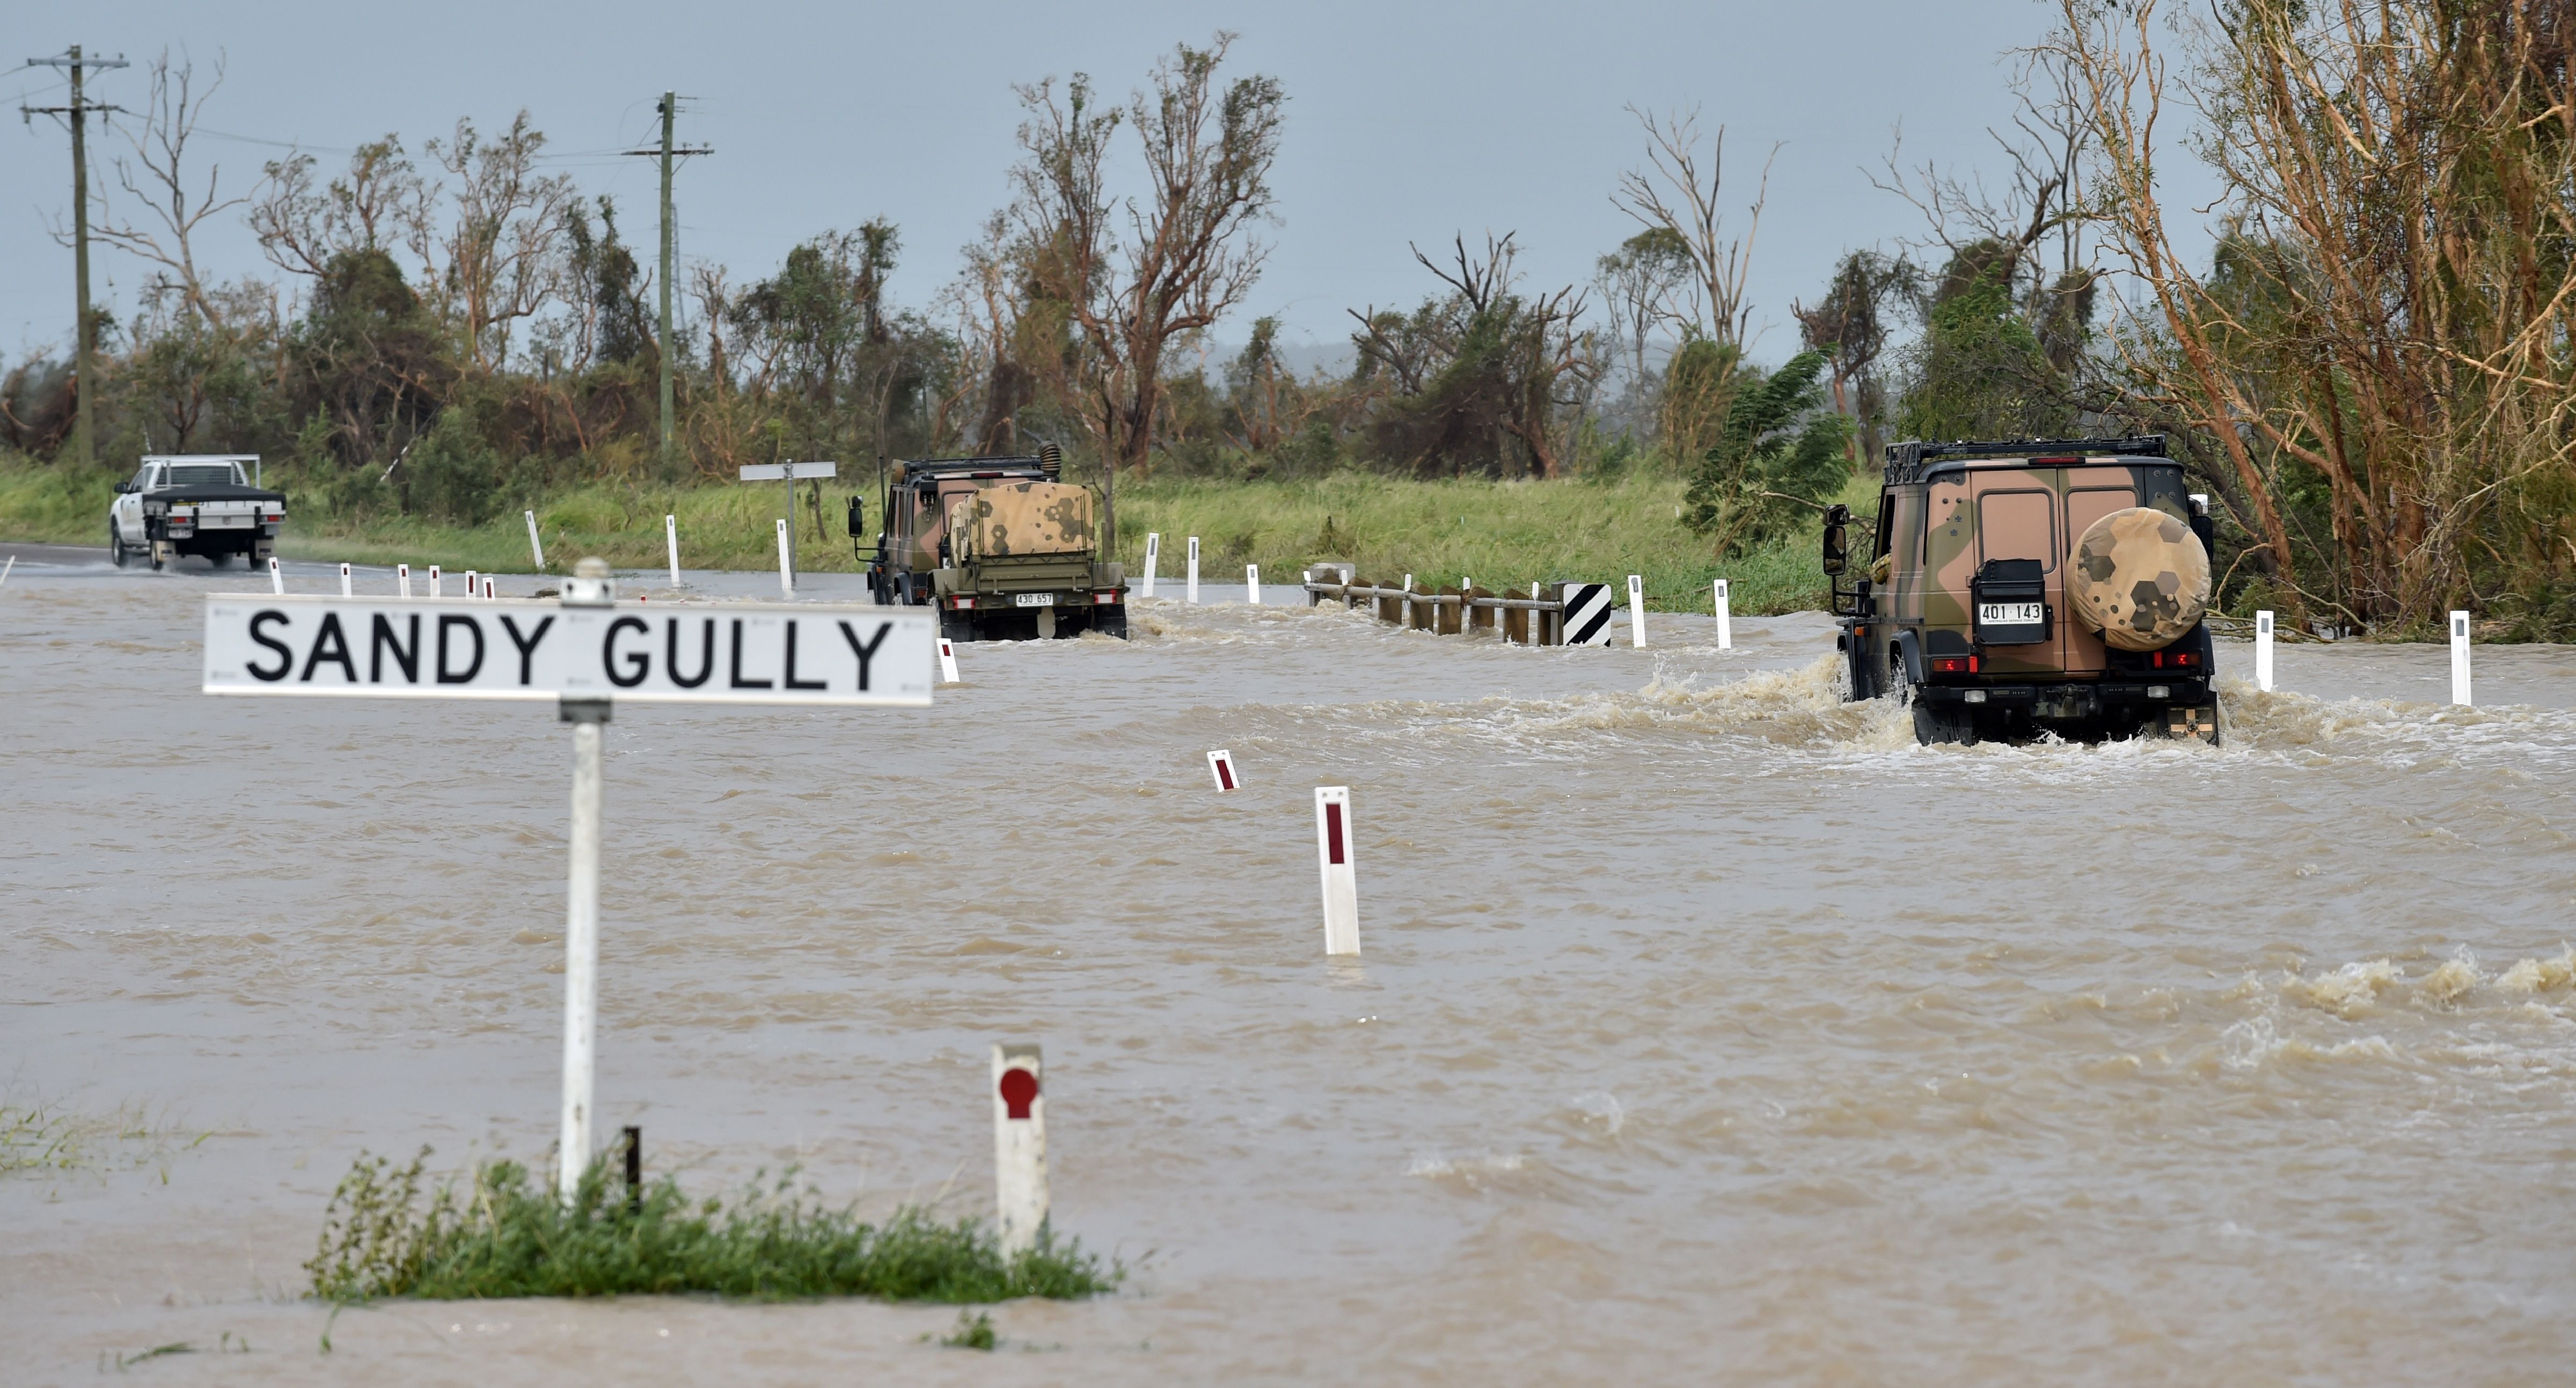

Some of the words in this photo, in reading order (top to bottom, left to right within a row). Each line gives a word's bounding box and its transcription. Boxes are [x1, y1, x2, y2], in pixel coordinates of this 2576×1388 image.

[1018, 595, 1033, 603] 430
[1037, 594, 1051, 602] 657
[1982, 605, 2005, 619] 401
[2017, 604, 2040, 619] 143
[245, 609, 555, 685] SANDY
[602, 616, 894, 692] GULLY
